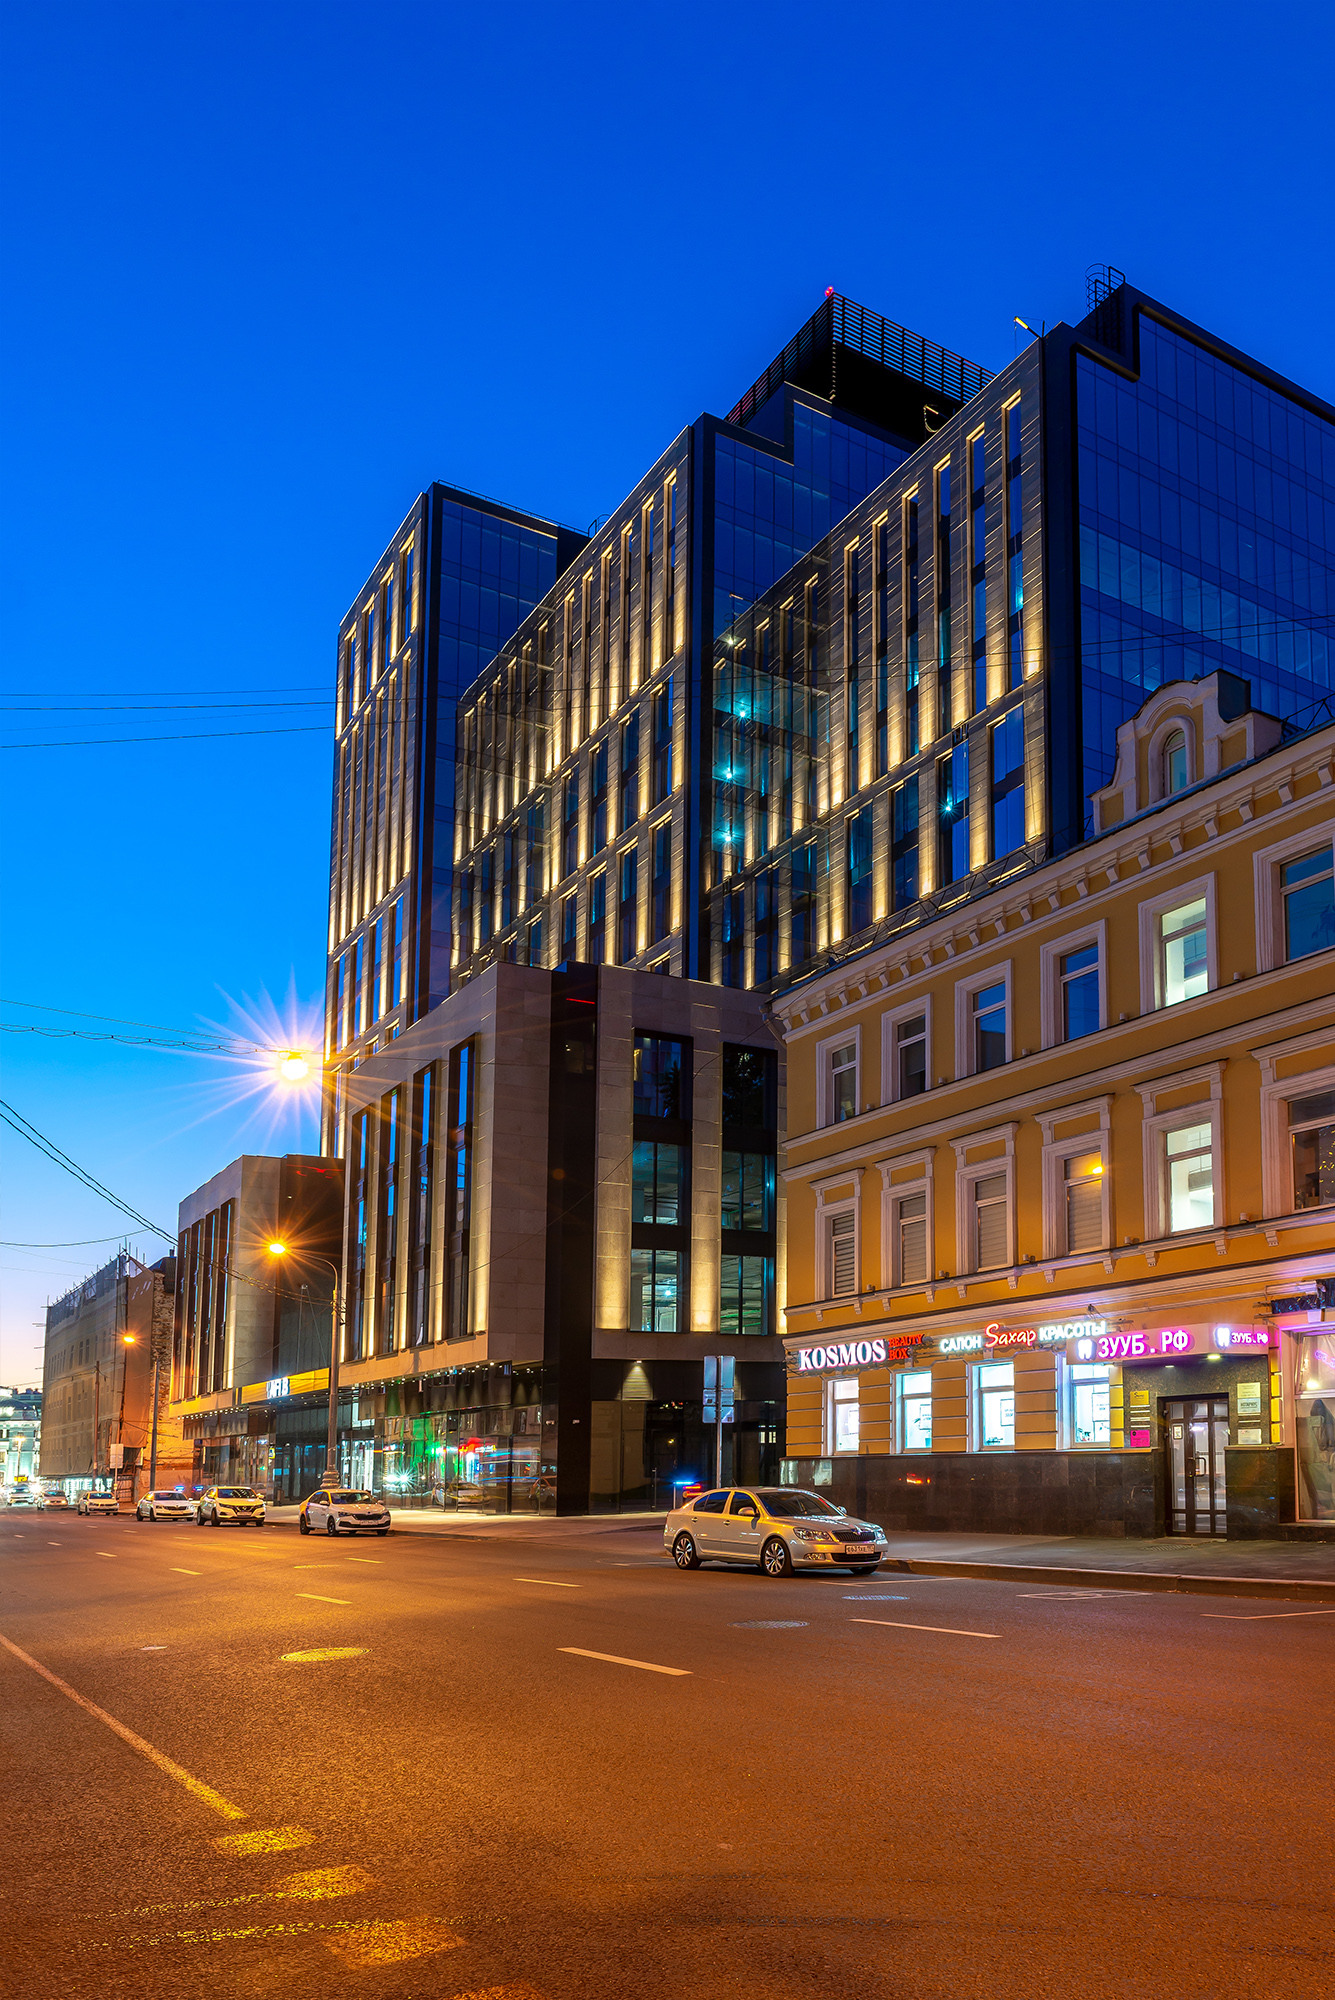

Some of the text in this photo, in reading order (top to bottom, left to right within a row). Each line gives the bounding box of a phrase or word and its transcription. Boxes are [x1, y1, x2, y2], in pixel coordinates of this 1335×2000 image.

[888, 1333, 925, 1348] BEAUTY
[940, 1335, 982, 1353] САЛОН
[1039, 1321, 1106, 1343] КРАСОТЫ
[798, 1338, 887, 1372] KOSMOS
[888, 1347, 910, 1361] BOX
